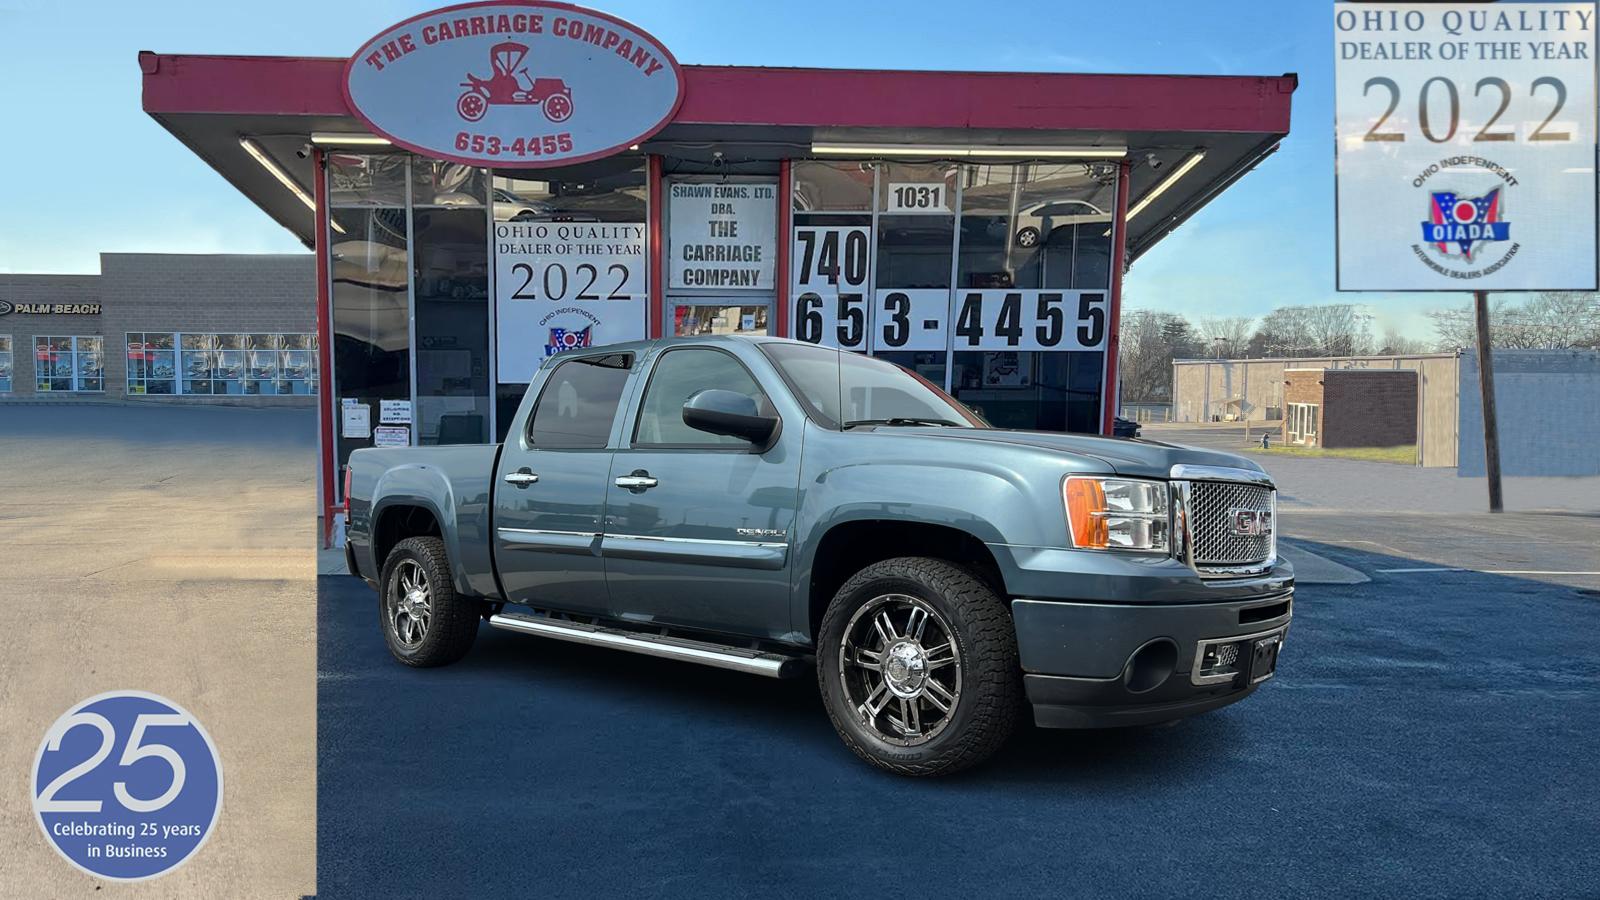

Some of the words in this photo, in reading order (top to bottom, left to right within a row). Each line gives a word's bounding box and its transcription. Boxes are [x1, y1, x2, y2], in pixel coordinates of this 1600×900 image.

[1336, 10, 1425, 31] OHIO
[1442, 10, 1593, 35] QUALITY
[365, 34, 417, 72] THE
[422, 14, 544, 45] CARRIAGE
[552, 17, 664, 77] COMPANY
[1340, 42, 1433, 60] DEALER
[1439, 42, 1469, 60] OF
[1475, 42, 1522, 60] THE
[1528, 42, 1589, 60] YEAR
[1363, 76, 1571, 143] 2022
[455, 131, 573, 156] 653-4455
[1413, 164, 1439, 188] OHIO
[1440, 156, 1519, 187] INDEPENDENT
[673, 186, 713, 198] SHAWN
[754, 187, 775, 199] LTD.
[895, 187, 940, 208] 1031
[711, 203, 736, 215] DBA.
[497, 226, 548, 239] OHIO
[558, 226, 644, 241] QUALITY
[708, 221, 738, 238] THE
[1432, 224, 1495, 241] OIADA
[500, 244, 552, 255] DEALER
[555, 244, 575, 255] OF
[577, 244, 604, 255] THE
[607, 244, 642, 255] YEAR
[683, 244, 762, 262] CARRIAGE
[797, 230, 868, 286] 740
[511, 263, 632, 301] 2022
[683, 268, 760, 286] COMPANY
[1450, 269, 1482, 279] DEALERS
[15, 304, 51, 314] PALM
[540, 312, 555, 326] OHIO
[555, 307, 601, 326] INDEPENDENT
[1236, 511, 1272, 534] GMC
